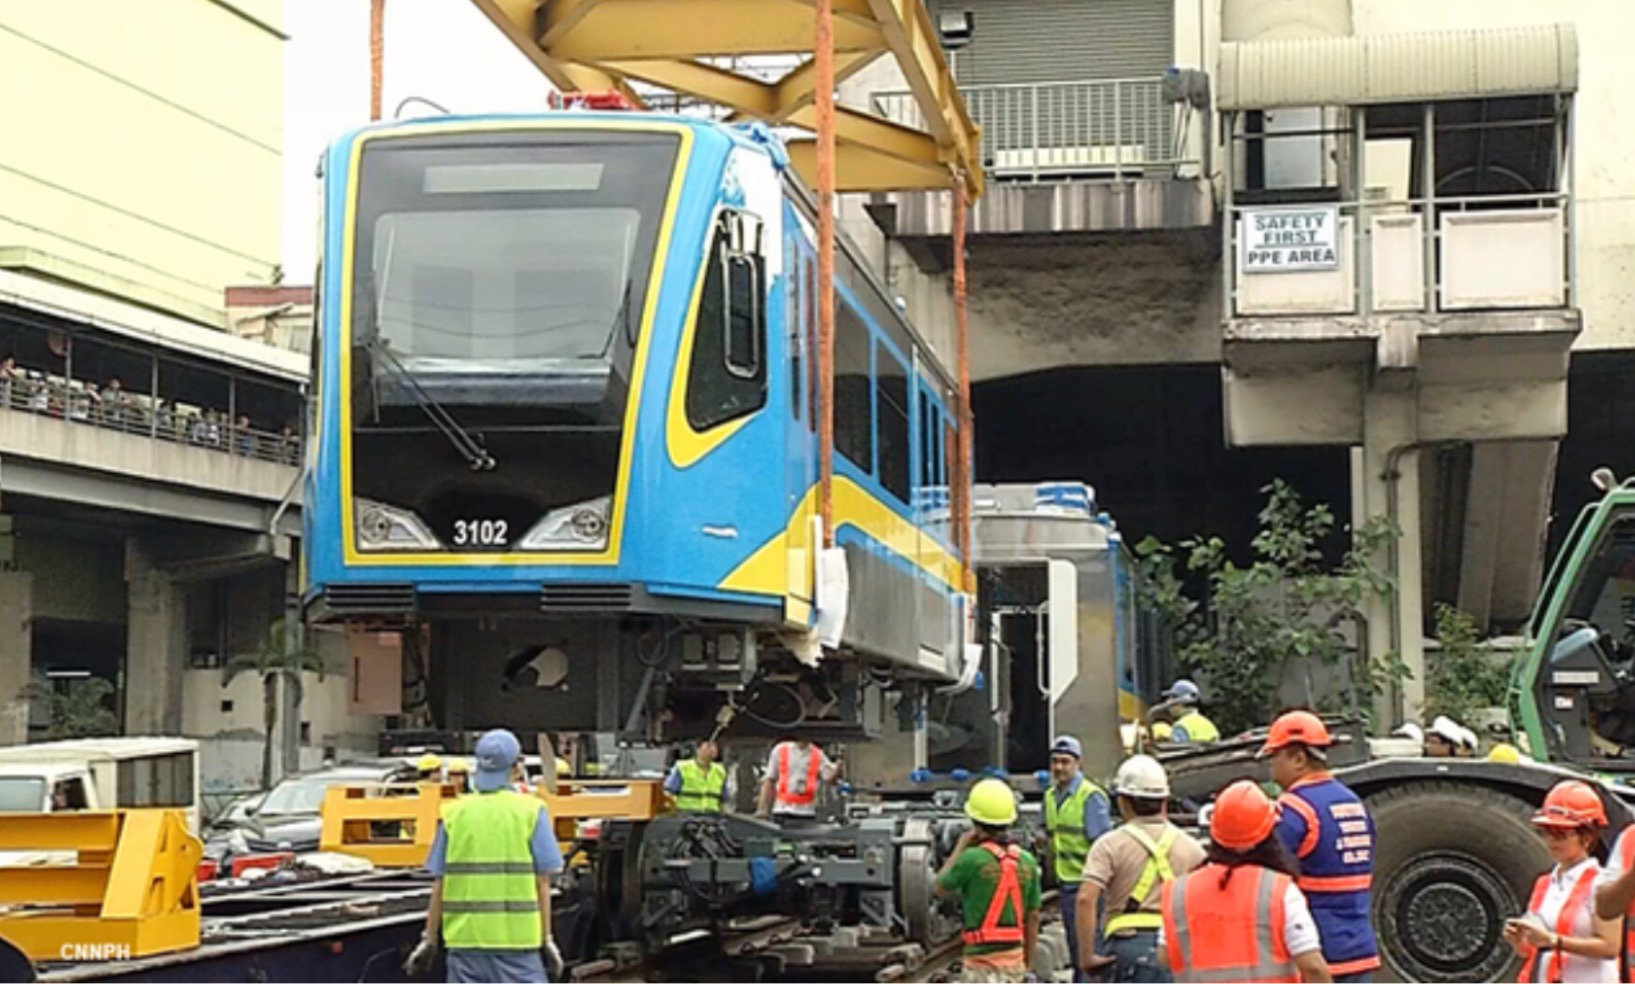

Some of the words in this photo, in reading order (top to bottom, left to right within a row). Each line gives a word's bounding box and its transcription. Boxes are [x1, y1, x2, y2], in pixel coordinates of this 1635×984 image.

[1255, 212, 1326, 230] SAFETY
[1264, 229, 1317, 244] FIRST
[1247, 250, 1282, 264] PPE
[1287, 247, 1335, 263] AREA
[453, 520, 508, 545] 3102
